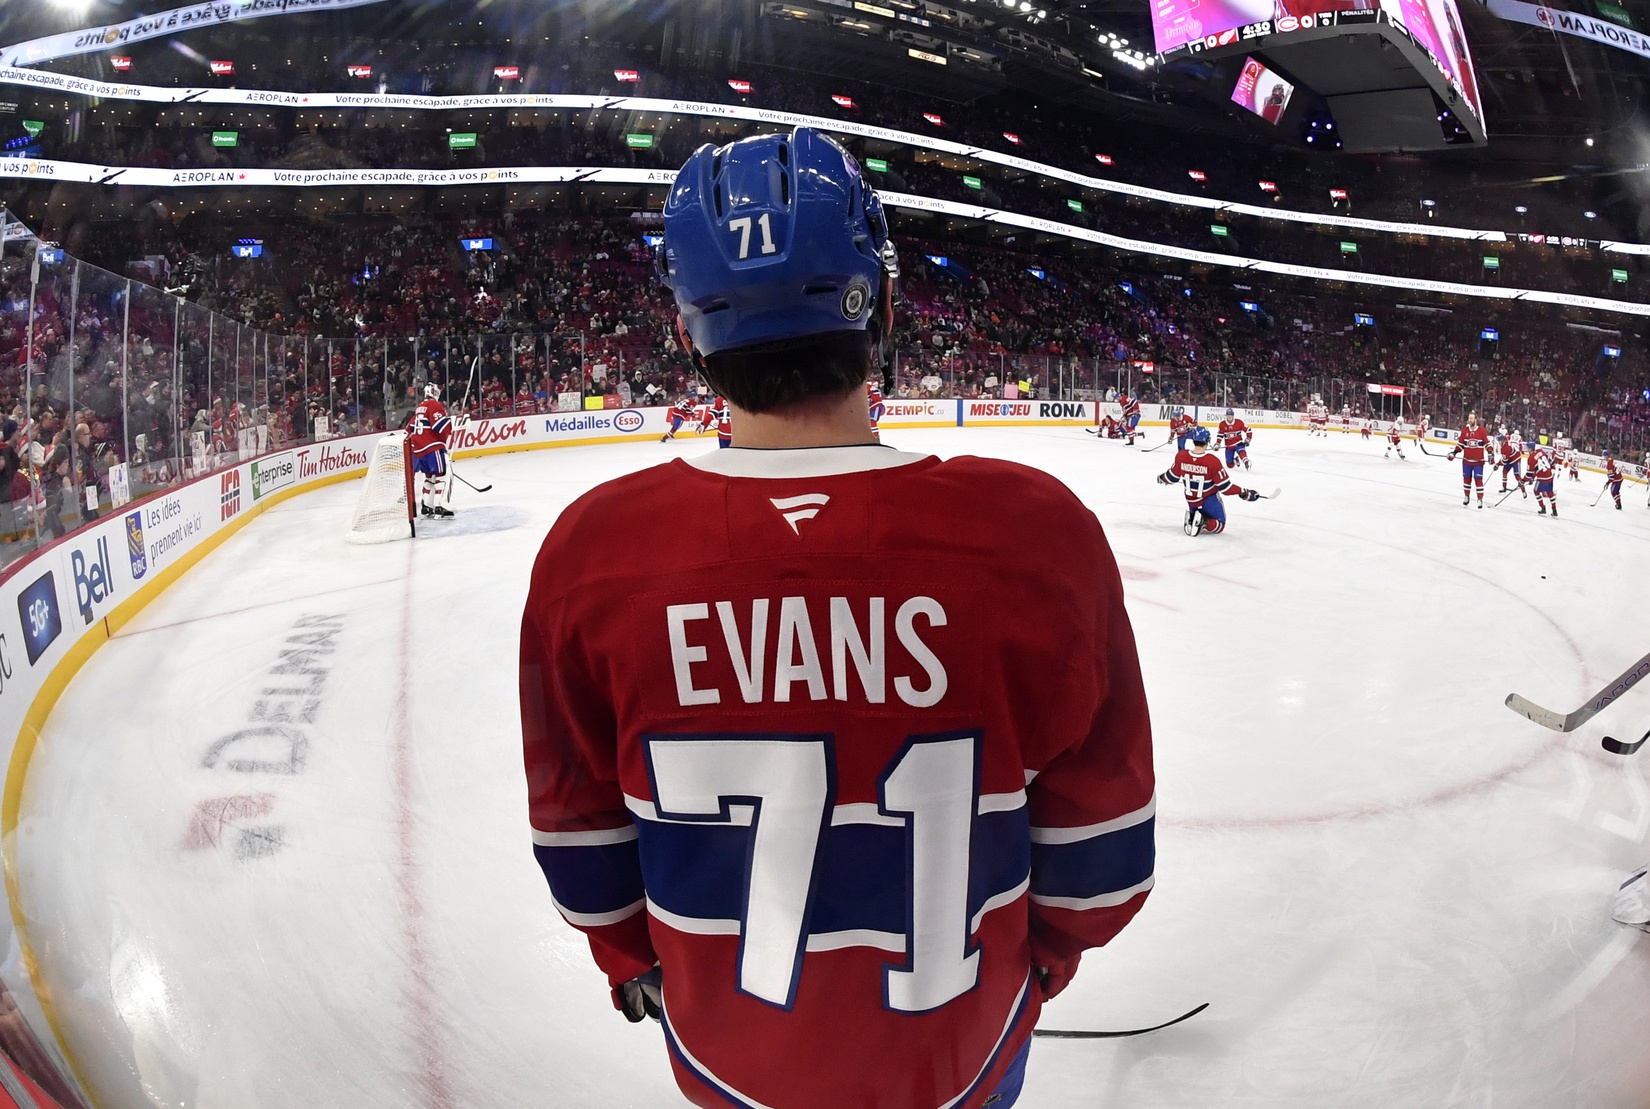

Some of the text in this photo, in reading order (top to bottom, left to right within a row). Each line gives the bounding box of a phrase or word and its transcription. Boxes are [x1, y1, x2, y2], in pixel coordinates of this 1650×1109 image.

[1243, 21, 1271, 35] 4:30
[1301, 15, 1313, 28] 0
[97, 86, 110, 94] vos
[111, 86, 141, 97] points
[246, 93, 299, 104] AEROPLAN
[335, 95, 361, 104] Votre
[363, 95, 411, 106] prochaine
[520, 96, 554, 106] points
[673, 103, 726, 114] AEROPLAN
[758, 111, 781, 121] Votre
[783, 114, 825, 128] prochaine
[910, 135, 934, 146] points
[3, 162, 54, 175] vos points
[173, 172, 235, 183] AEROPLAN
[274, 172, 302, 182] Votre
[304, 171, 358, 184] prochaine
[416, 171, 447, 183] grâce
[459, 173, 478, 181] vos
[480, 170, 519, 182] points
[902, 197, 917, 205] vos
[918, 199, 945, 210] points
[729, 213, 777, 260] 71
[1040, 403, 1086, 418] RONA
[1275, 411, 1293, 419] DOBEL
[545, 416, 640, 432] Médailles Esso
[297, 446, 368, 478] Tim Hortons
[1180, 463, 1208, 475] ANDERSON
[252, 460, 293, 488] enterprise
[1218, 469, 1228, 480] 17
[1183, 473, 1205, 498] 17
[146, 498, 181, 529] Les idées
[150, 512, 202, 567] prennent vie ici
[131, 556, 147, 578] RBC
[71, 535, 114, 617] Bell
[28, 598, 49, 638] 5G+
[666, 595, 948, 709] EVANS
[643, 732, 983, 1014] 71
